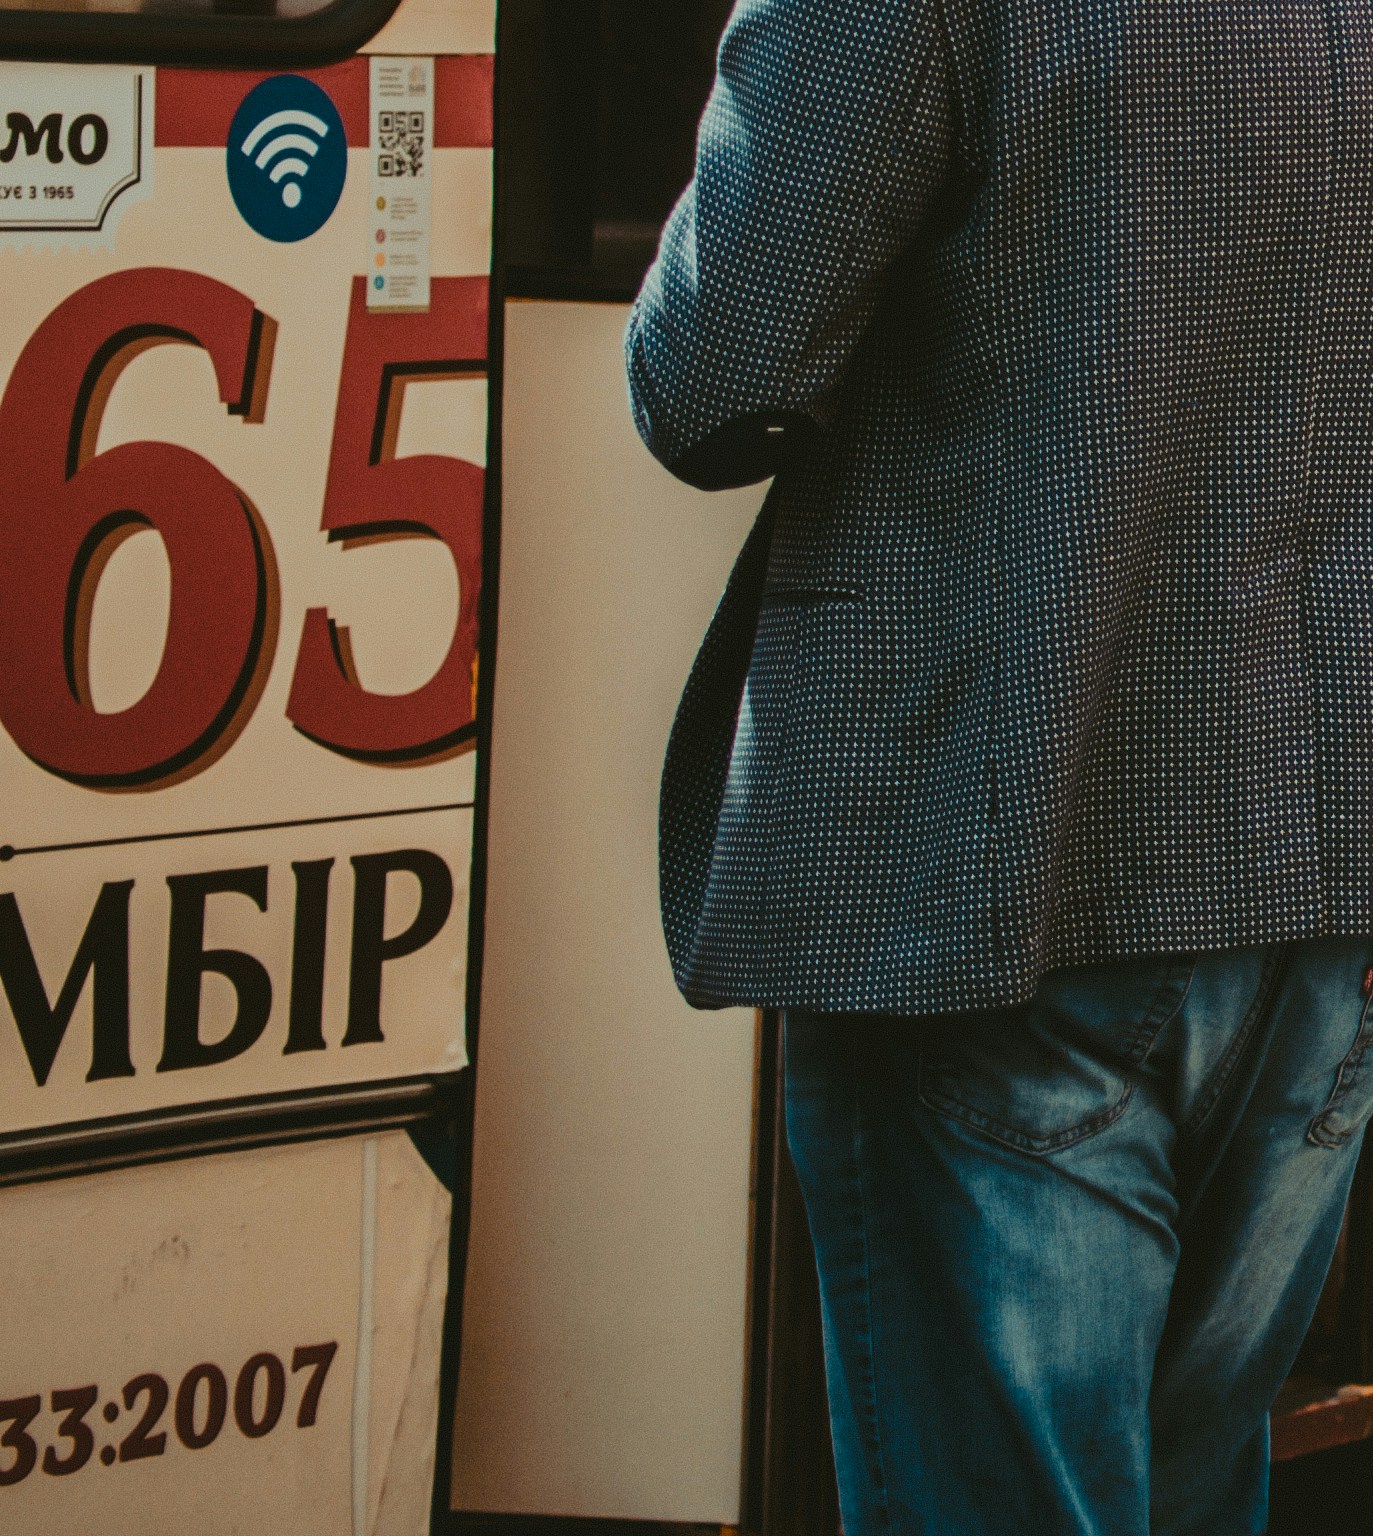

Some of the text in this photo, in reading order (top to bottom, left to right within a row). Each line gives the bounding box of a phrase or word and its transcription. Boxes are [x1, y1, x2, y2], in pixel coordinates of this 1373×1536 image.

[43, 186, 75, 200] 1965
[0, 267, 488, 795] 65
[0, 848, 454, 1087] МБІР
[0, 1340, 338, 1487] 33:2007
